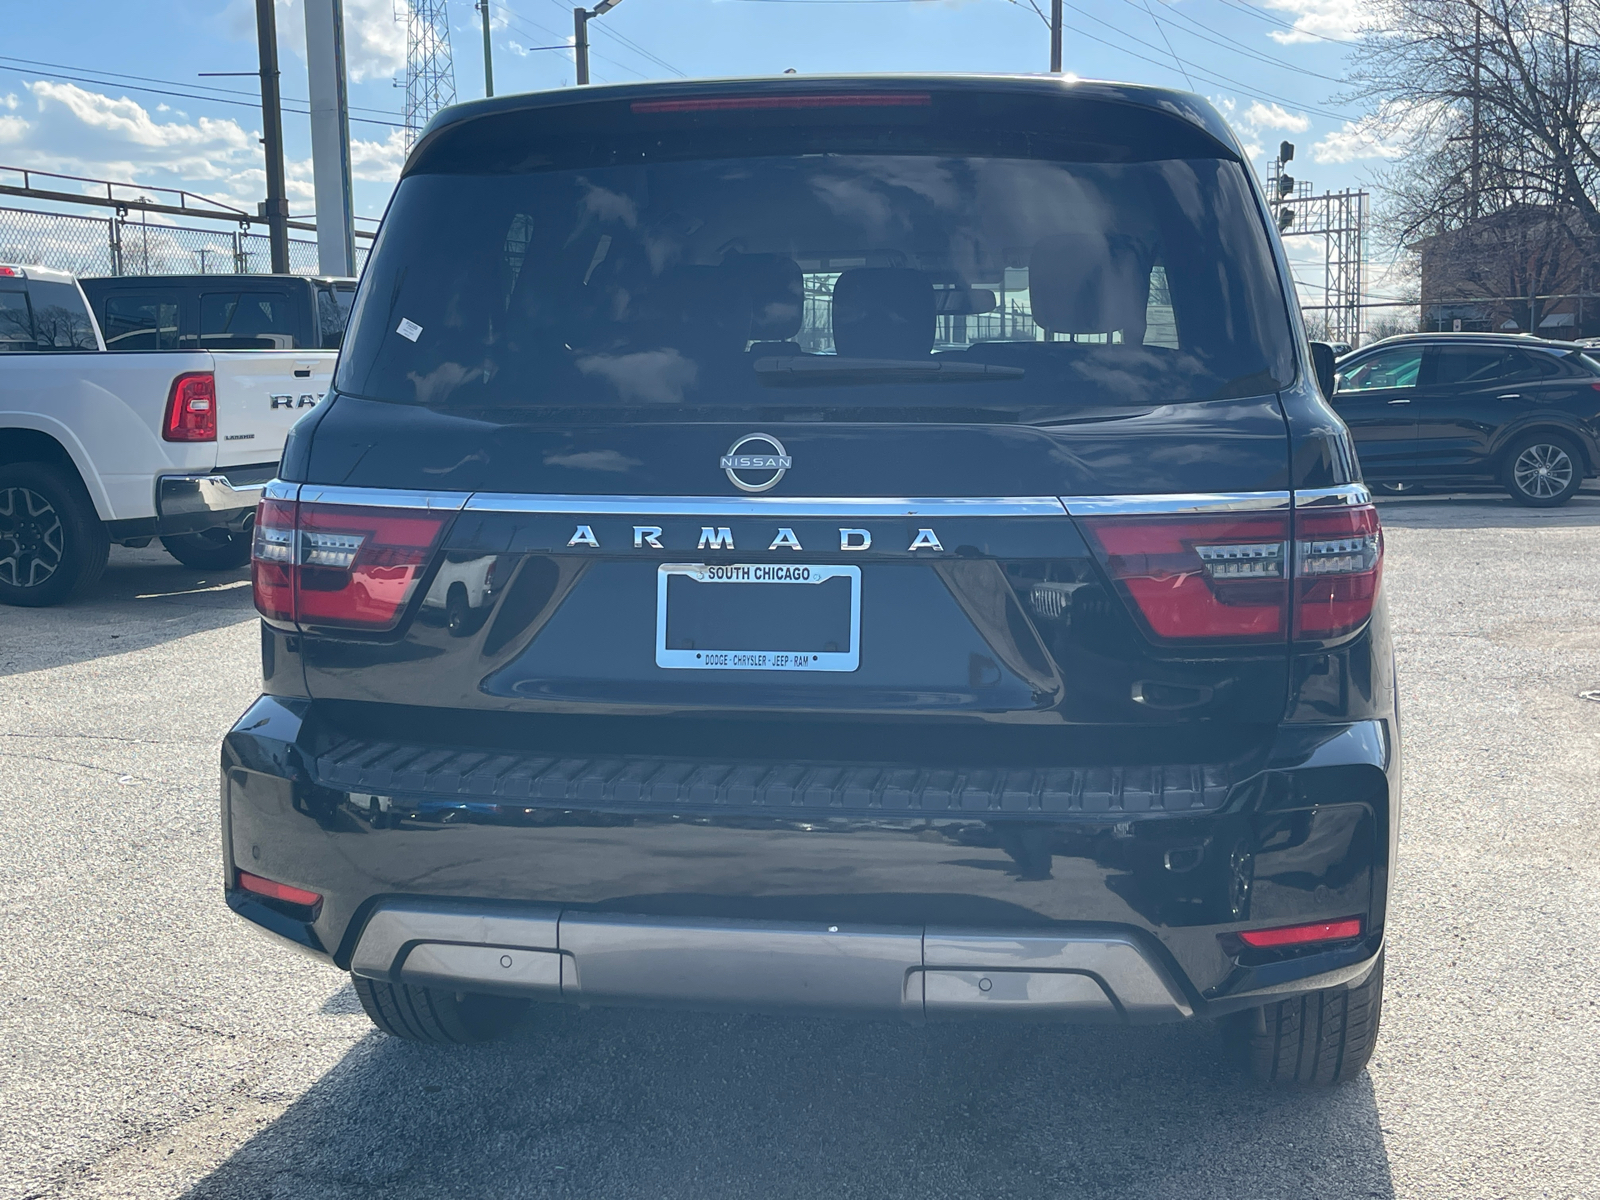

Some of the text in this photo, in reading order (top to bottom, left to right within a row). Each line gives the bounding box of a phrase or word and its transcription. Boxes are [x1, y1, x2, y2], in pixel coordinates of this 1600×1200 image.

[721, 457, 790, 467] NISSAN
[566, 525, 944, 552] ARMADA
[708, 566, 810, 580] SOUTH CHICAGO
[705, 654, 809, 667] DODGE CHRYSLER JEEP RAM
